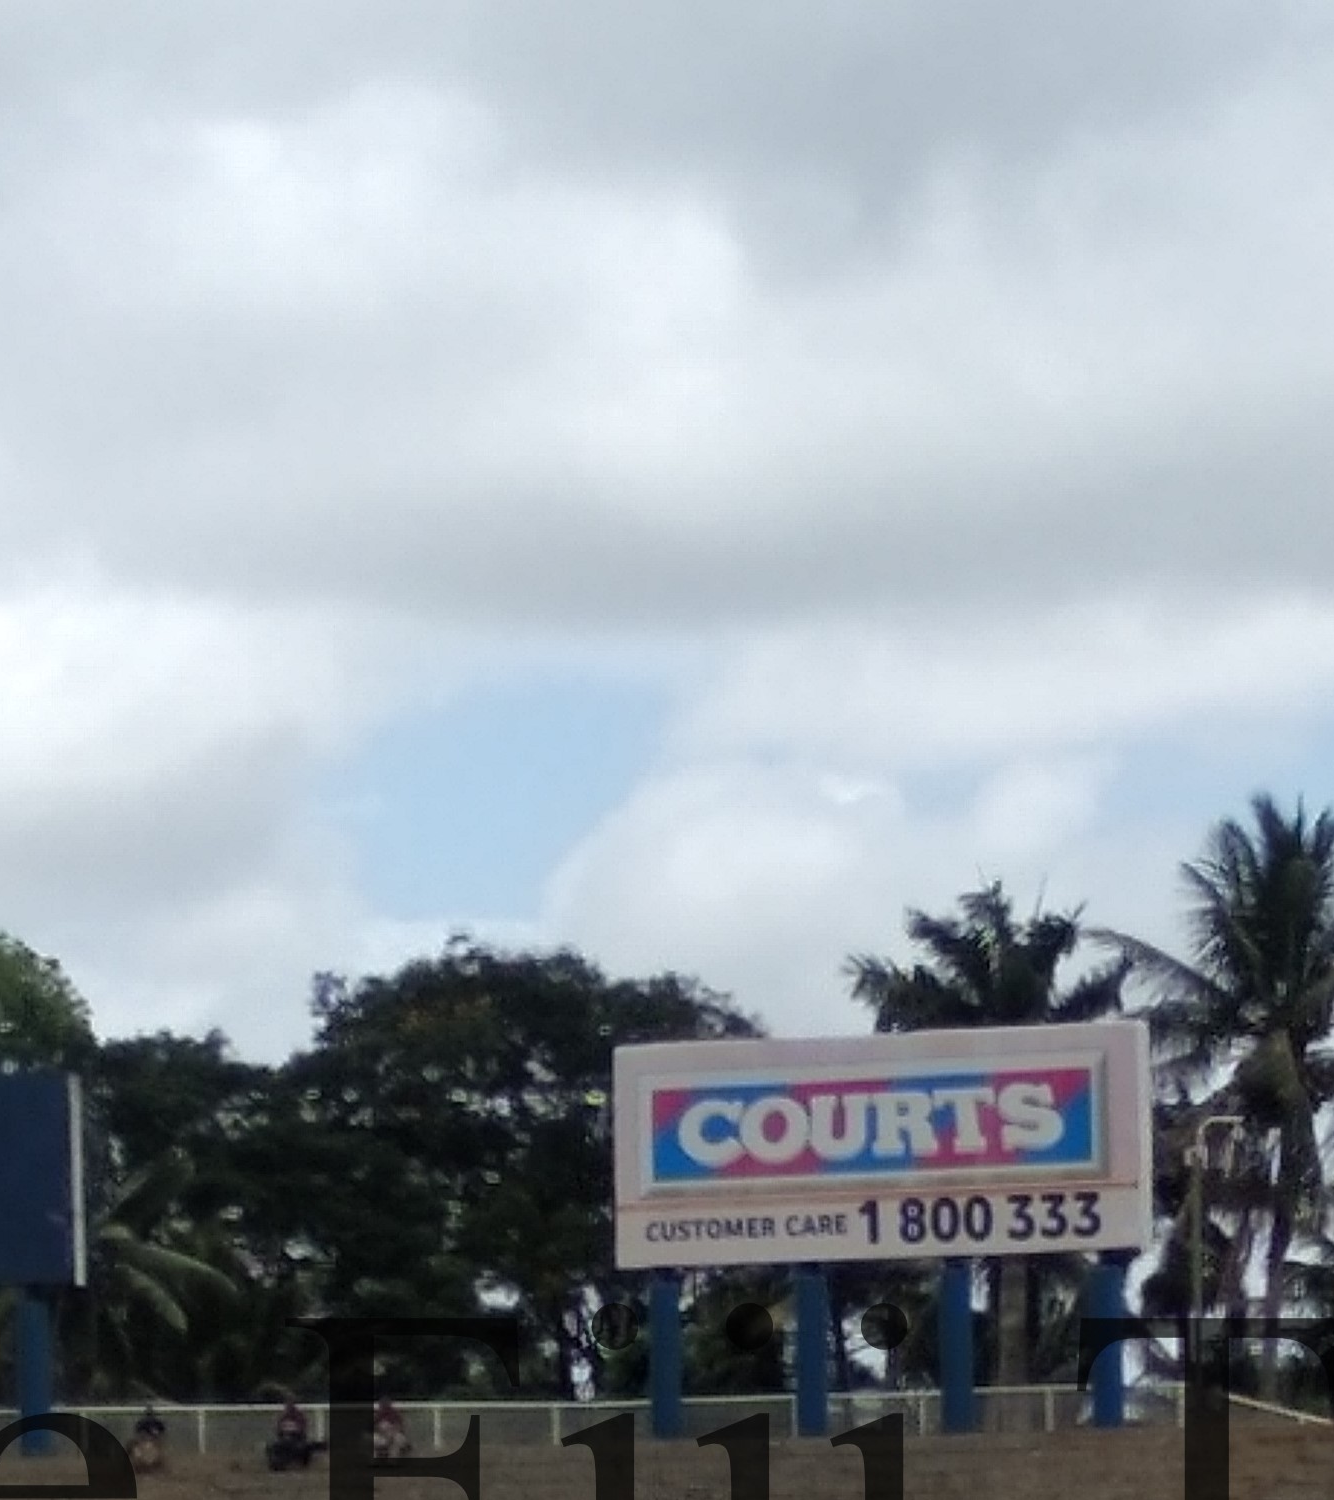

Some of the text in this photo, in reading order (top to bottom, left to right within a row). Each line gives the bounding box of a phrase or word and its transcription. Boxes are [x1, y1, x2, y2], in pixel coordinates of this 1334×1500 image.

[677, 1082, 1066, 1168] COURTS
[646, 1192, 1102, 1244] CUSTOMER CARE 1 800 333
